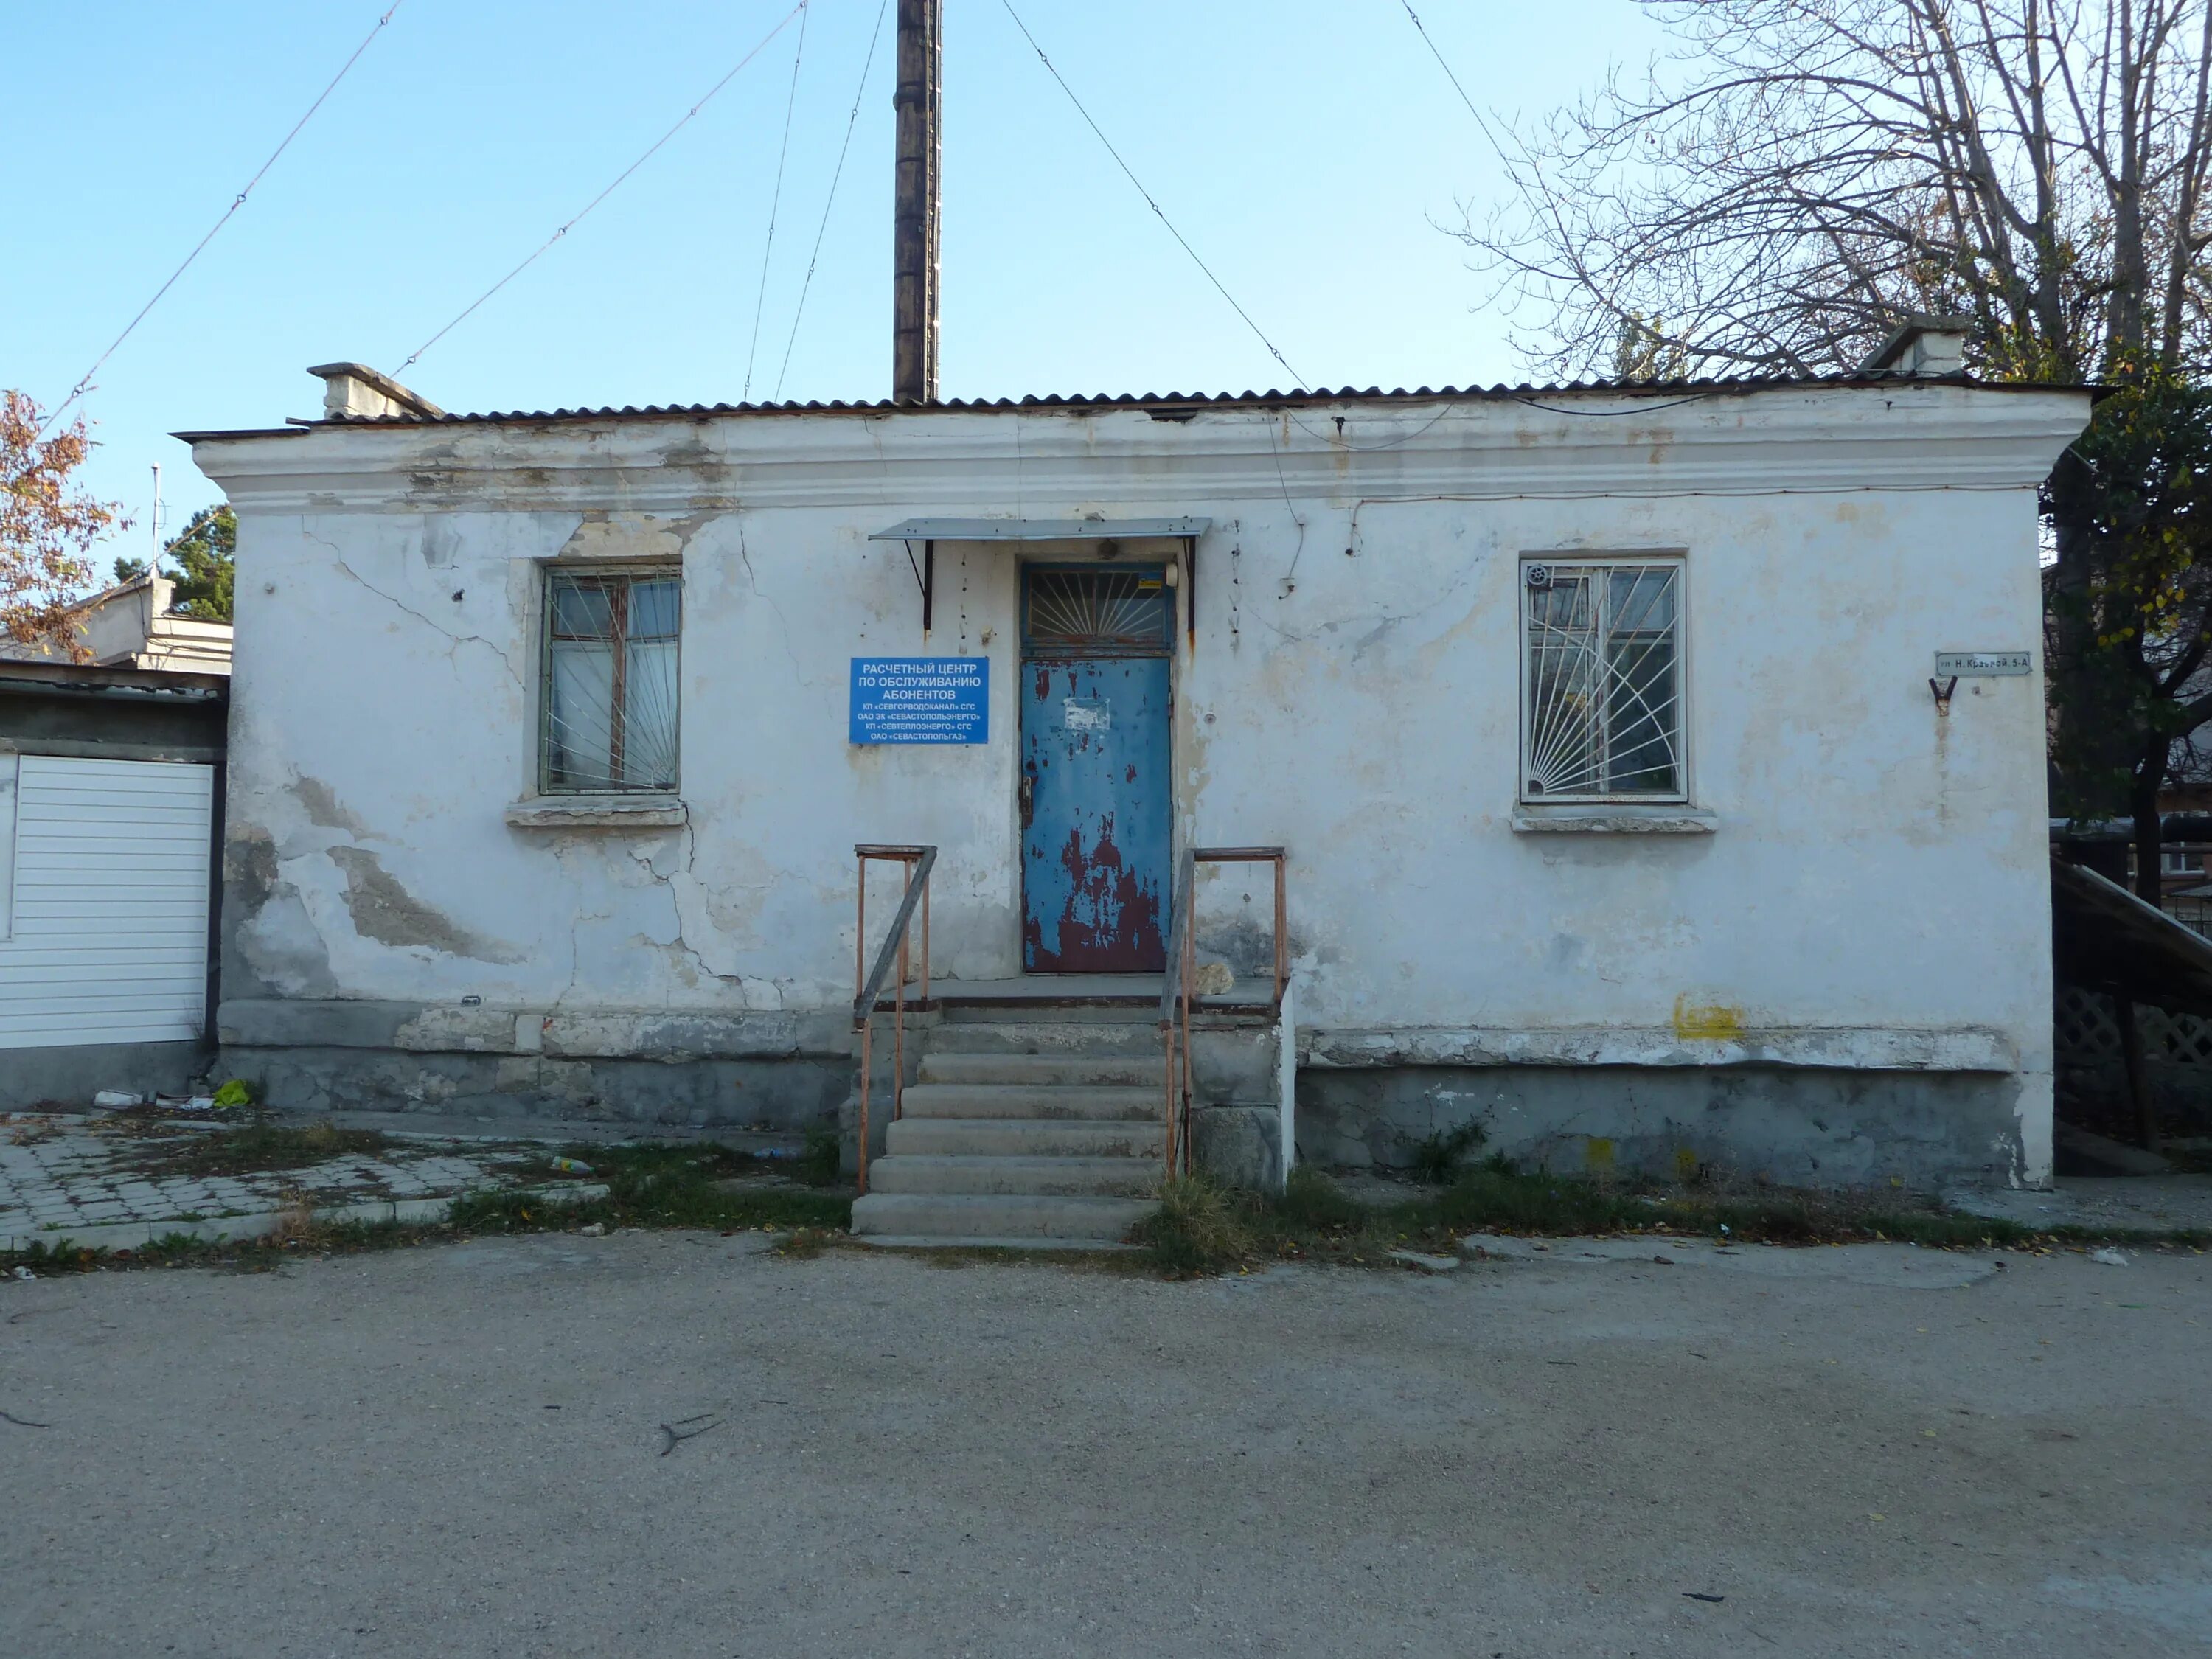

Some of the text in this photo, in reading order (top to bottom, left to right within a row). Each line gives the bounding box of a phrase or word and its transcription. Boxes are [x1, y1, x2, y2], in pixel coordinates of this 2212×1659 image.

[2012, 658, 2028, 667] 5-А
[863, 663, 977, 675] РАСЧЕТНЫЙ ЦЕНТР
[858, 677, 981, 686] ПО ОБСЛУЖИВАНИЮ
[883, 690, 956, 700] АБОНЕНТОВ
